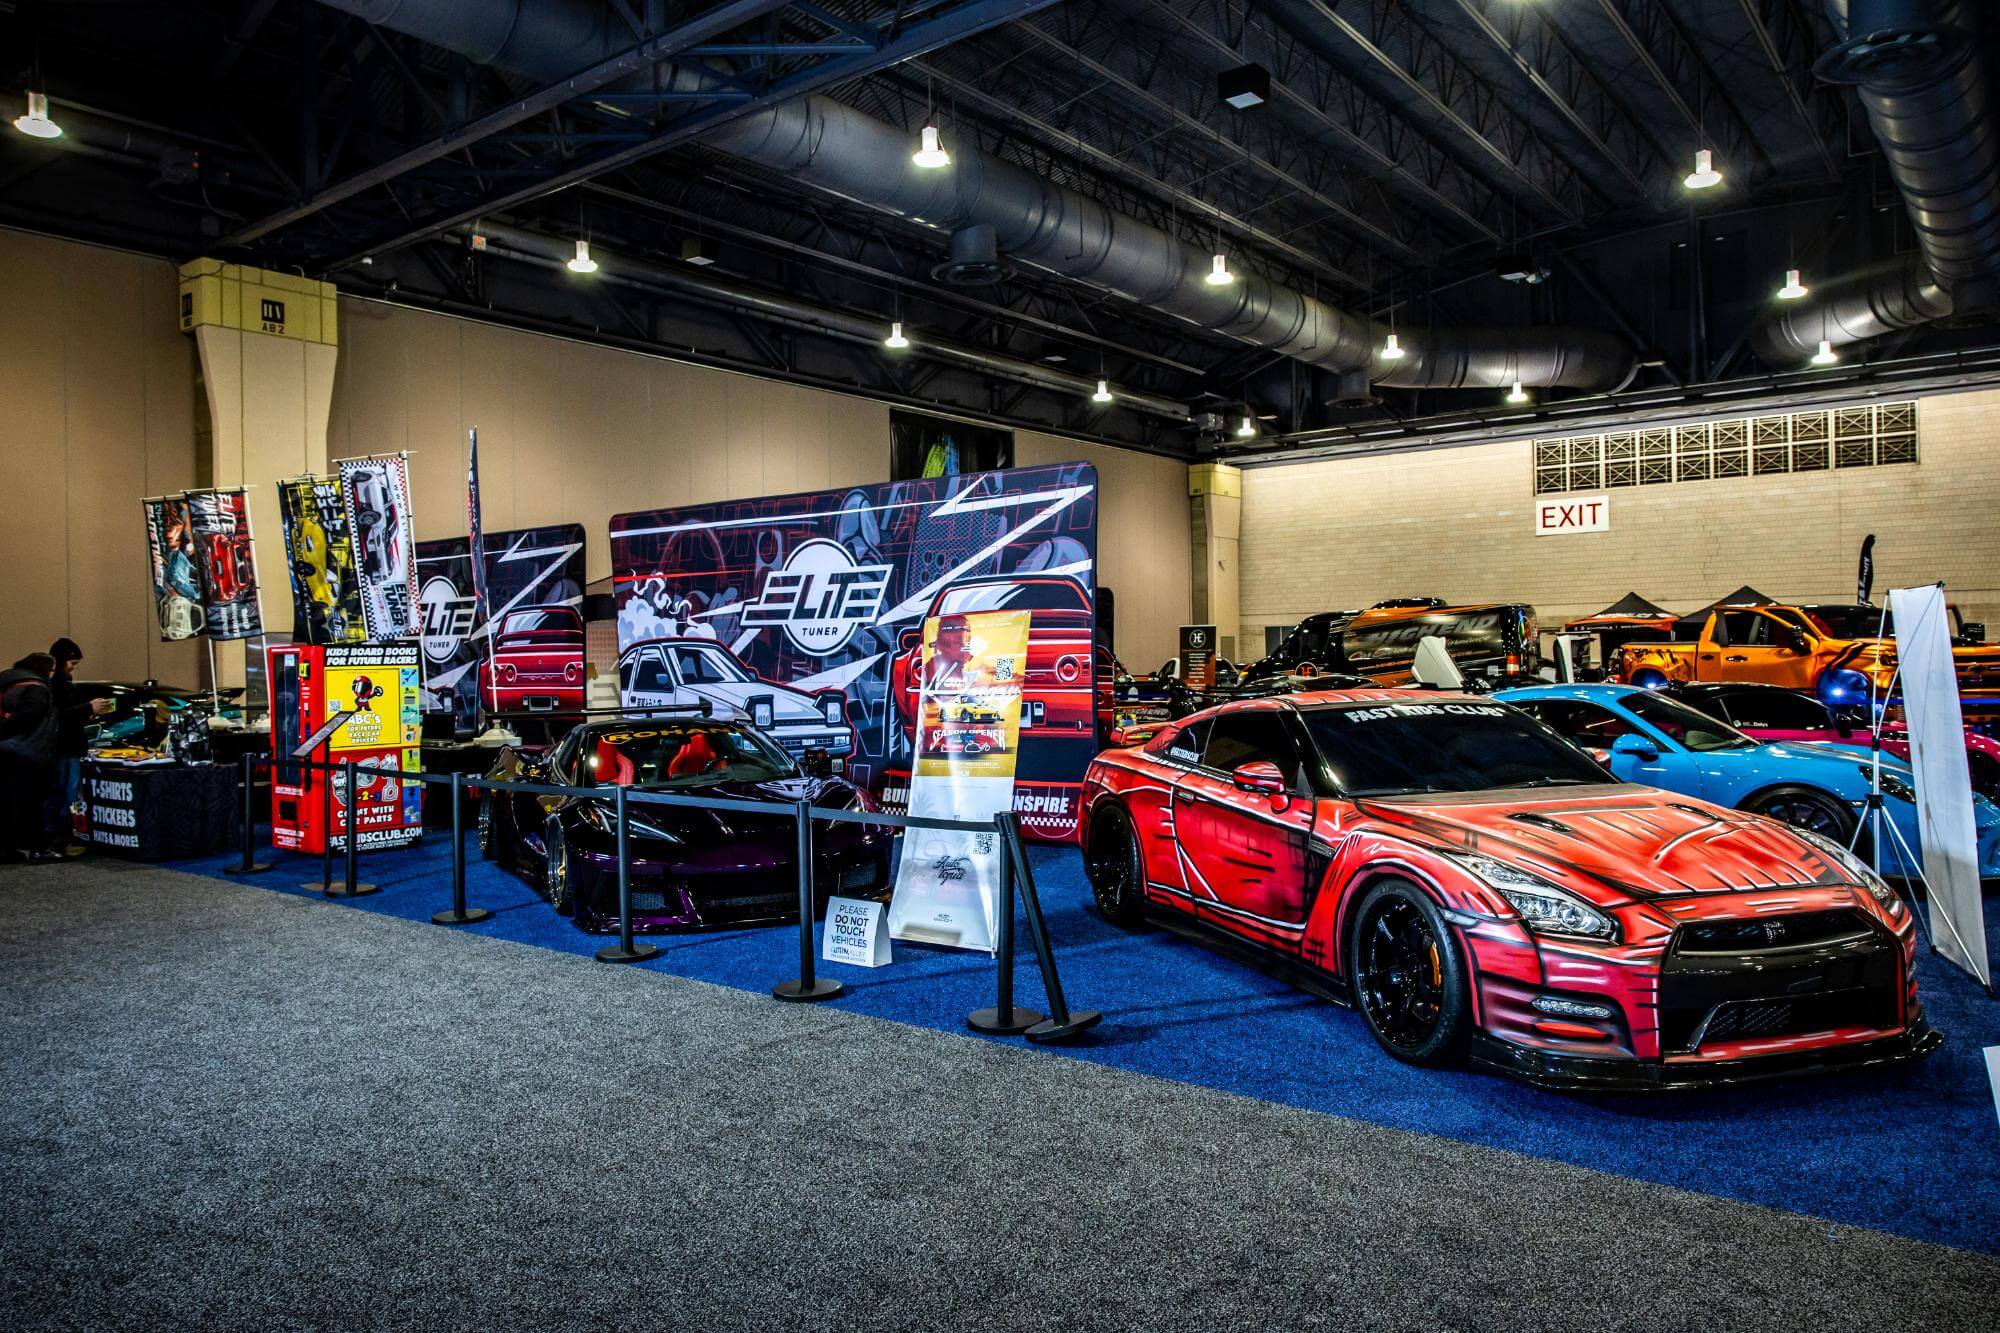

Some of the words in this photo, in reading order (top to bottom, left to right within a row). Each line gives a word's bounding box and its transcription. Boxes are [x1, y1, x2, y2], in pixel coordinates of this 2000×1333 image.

[1542, 503, 1603, 529] EXIT
[383, 584, 403, 627] TUNER
[802, 627, 839, 636] TUNER
[326, 647, 349, 657] KIDS
[350, 647, 384, 657] BOARD
[385, 647, 418, 656] BOOKS
[326, 657, 347, 666] FOR
[347, 656, 383, 665] FUTURE
[383, 655, 417, 665] RACERS
[1344, 703, 1398, 724] FAST
[91, 779, 133, 802] T-SHIRTS
[92, 805, 136, 828] STICKERS
[371, 805, 395, 815] WITH
[363, 814, 393, 825] PARTS
[114, 833, 139, 848] MORE!
[839, 904, 869, 917] PLEASE
[835, 914, 849, 925] DO
[850, 916, 869, 927] NOT
[835, 924, 866, 937] TOUCH
[831, 934, 867, 949] VEHICLES
